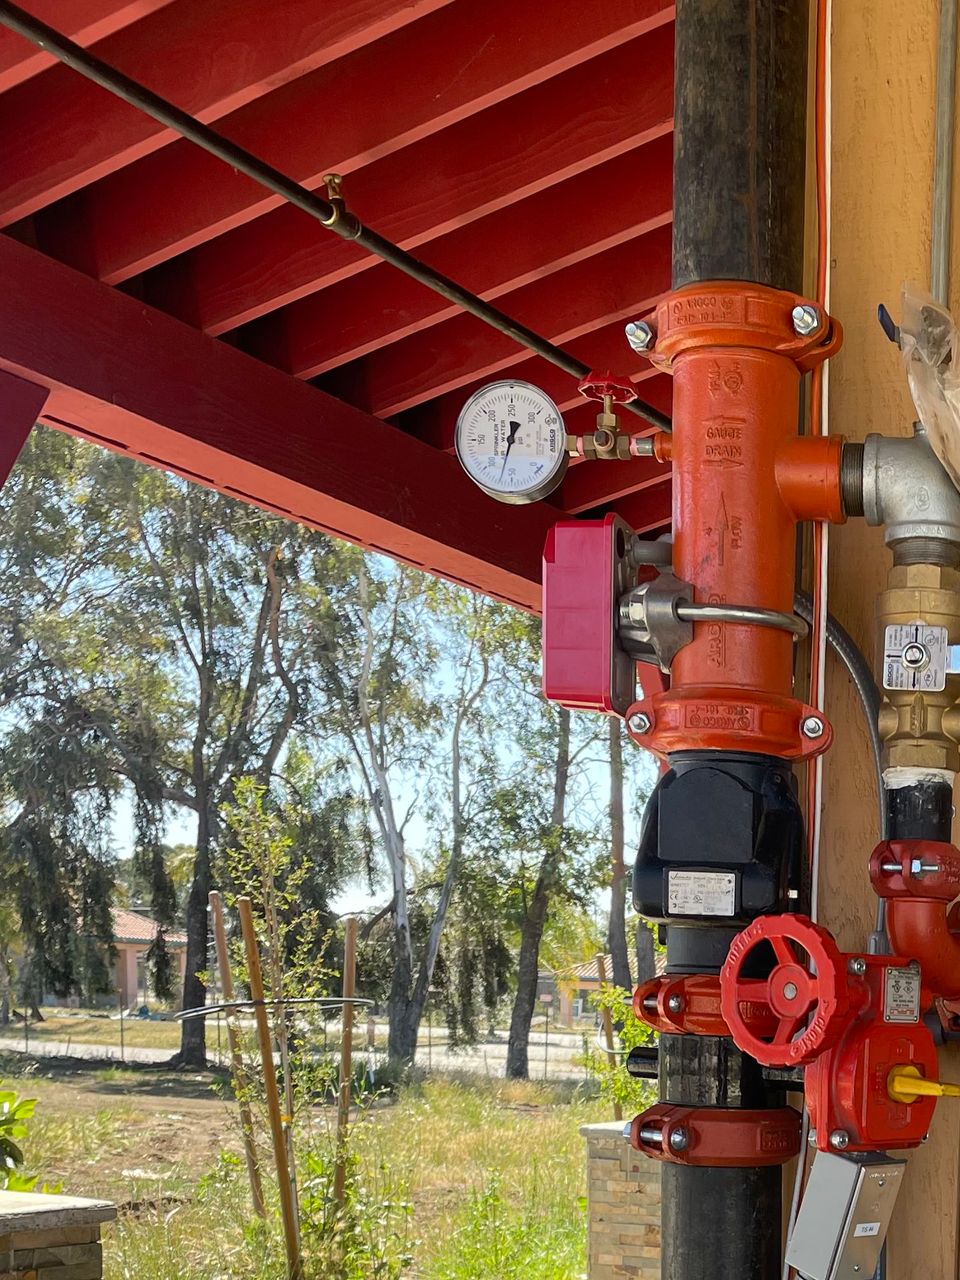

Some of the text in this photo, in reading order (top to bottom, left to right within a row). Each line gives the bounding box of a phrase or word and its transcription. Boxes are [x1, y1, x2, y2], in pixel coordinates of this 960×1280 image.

[488, 410, 496, 422] 200
[508, 404, 516, 417] 250
[527, 411, 536, 424] 300
[477, 433, 486, 445] 150
[706, 426, 742, 440] GAUGE
[705, 445, 742, 458] DRAIN
[488, 456, 496, 467] 100
[508, 467, 516, 476] 50
[730, 514, 743, 550] FLOW
[707, 593, 721, 668] ARGO
[728, 931, 752, 965] OPEN
[799, 1017, 826, 1055] CLOSE
